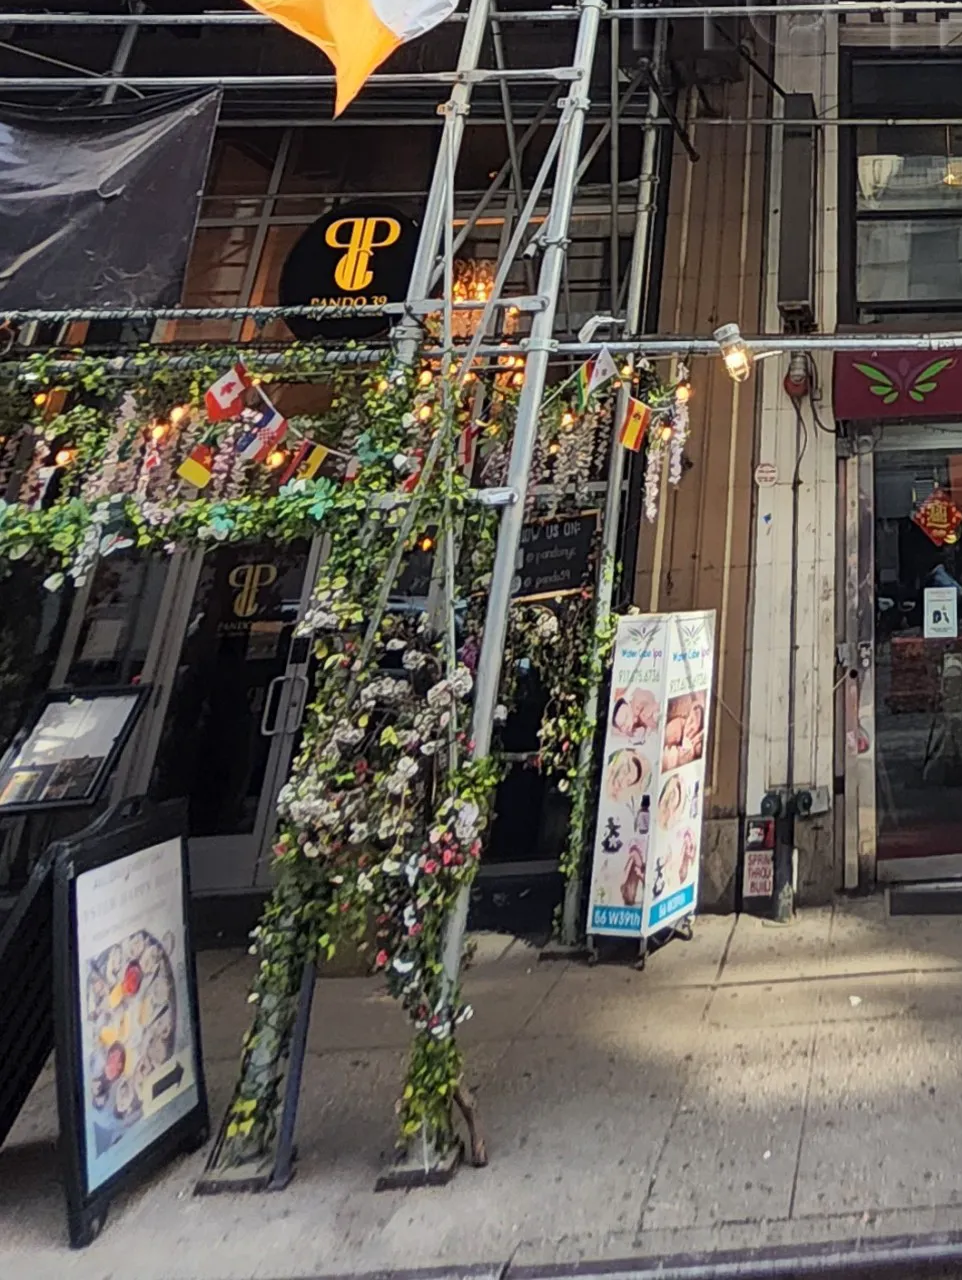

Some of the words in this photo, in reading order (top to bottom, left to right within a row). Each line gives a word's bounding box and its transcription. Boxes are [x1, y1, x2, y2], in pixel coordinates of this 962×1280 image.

[371, 295, 388, 306] 39
[546, 522, 559, 540] US
[594, 909, 607, 925] 56
[608, 910, 640, 926] W39th
